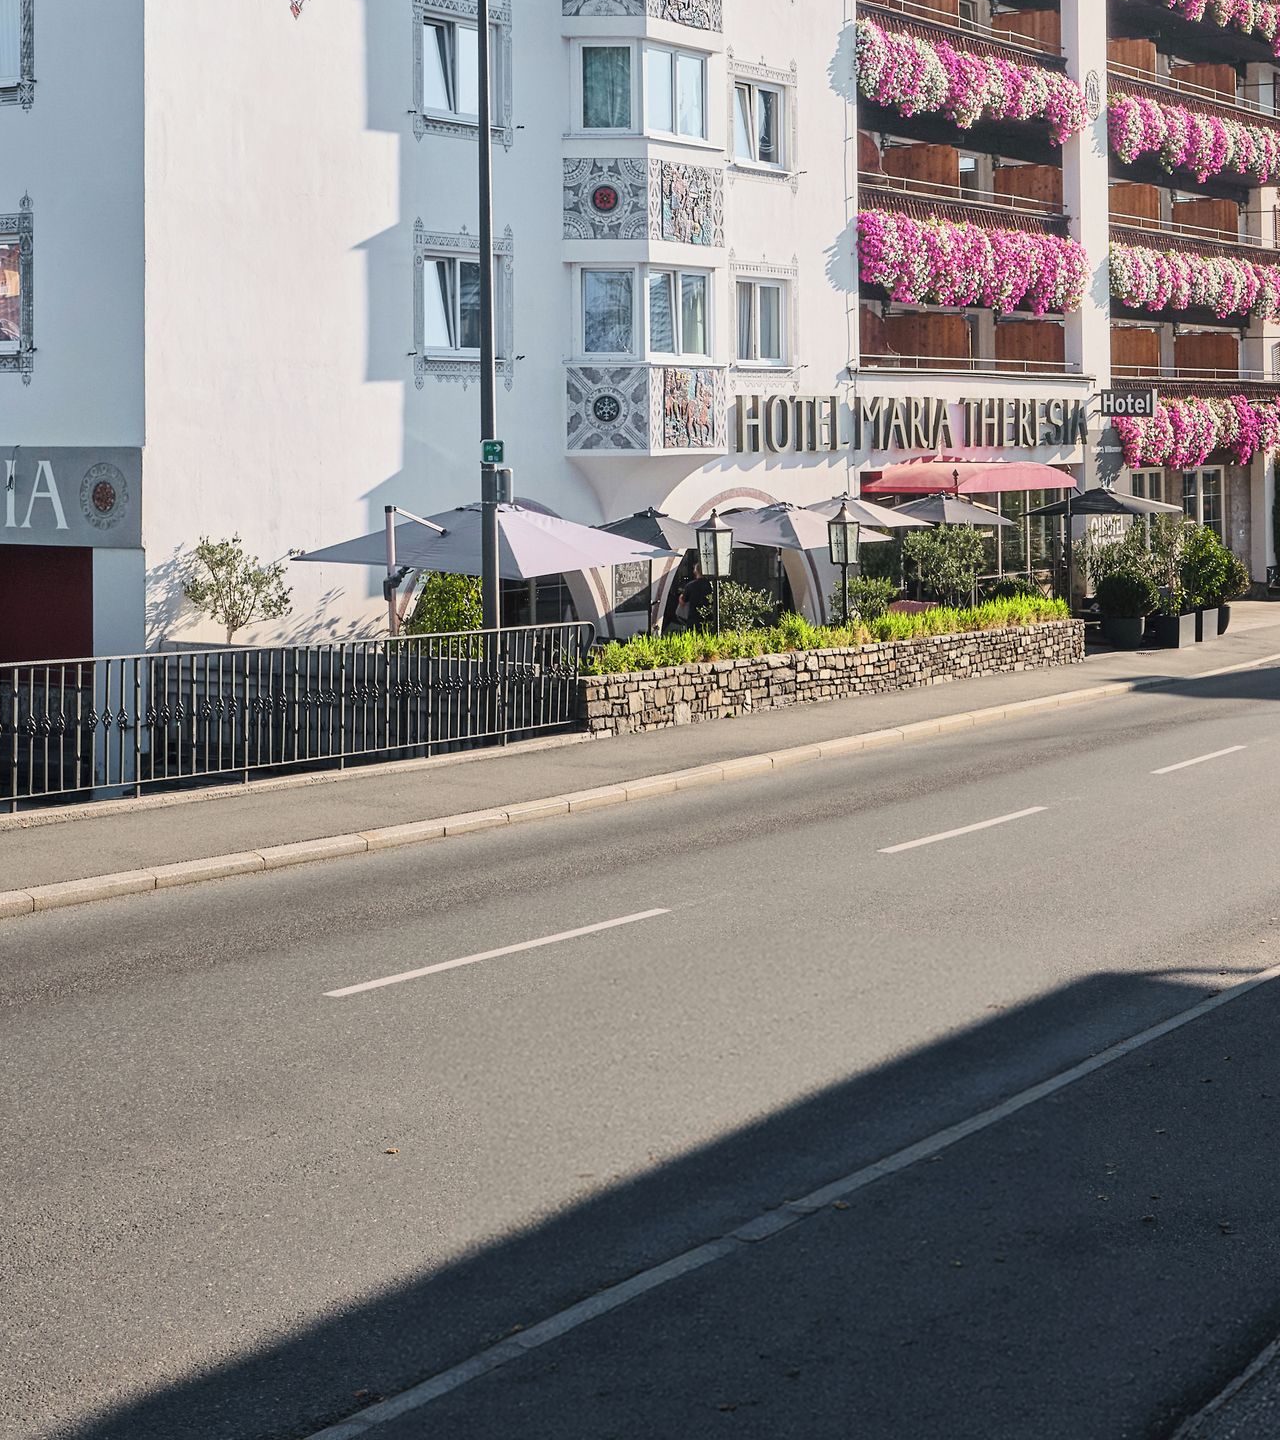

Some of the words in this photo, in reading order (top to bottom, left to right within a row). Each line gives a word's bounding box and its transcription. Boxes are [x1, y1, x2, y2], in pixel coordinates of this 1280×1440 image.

[1103, 393, 1150, 413] Hotel
[735, 394, 850, 454] HOTEL
[854, 396, 953, 451] MARIA
[959, 396, 1089, 448] THERESIA
